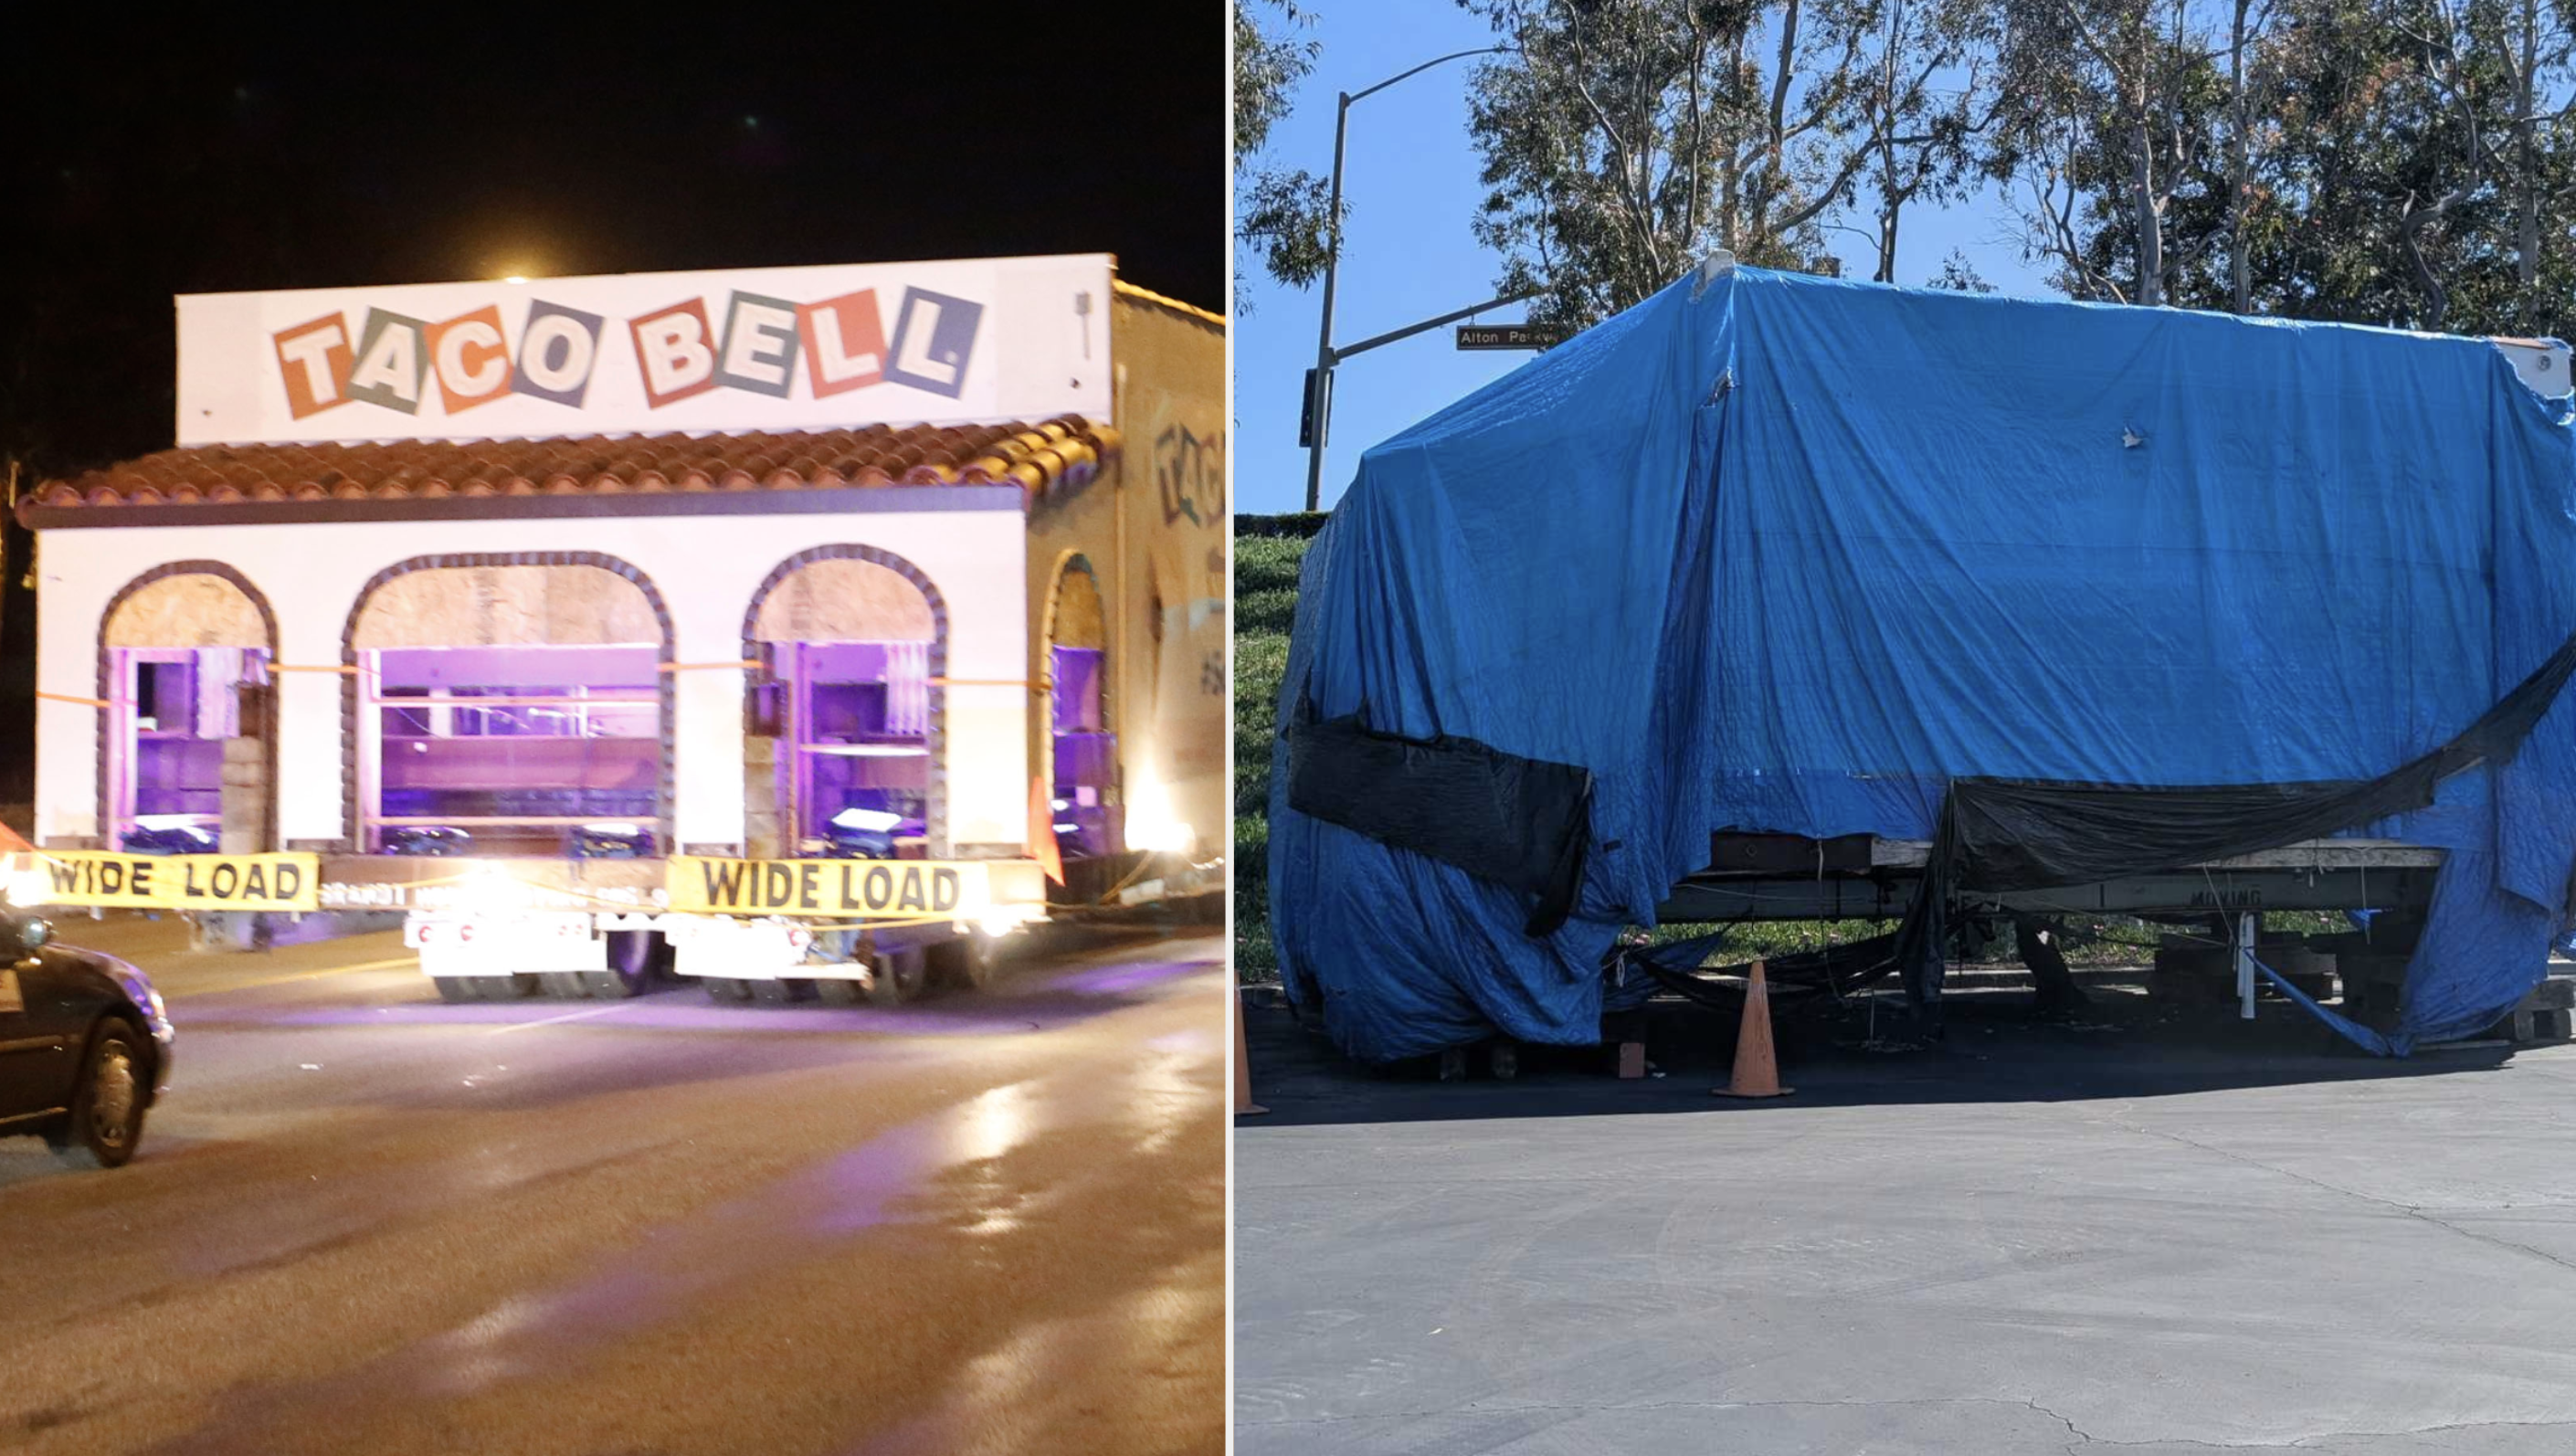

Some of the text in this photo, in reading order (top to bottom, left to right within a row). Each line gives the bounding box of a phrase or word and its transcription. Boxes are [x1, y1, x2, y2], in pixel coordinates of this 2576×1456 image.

[279, 297, 957, 406] TACO BELL
[1461, 331, 1499, 343] Alton
[47, 860, 301, 900] WIDE LOAD
[701, 860, 820, 909] WIDE
[839, 864, 960, 912] LOAD
[2191, 889, 2262, 905] MOVING
